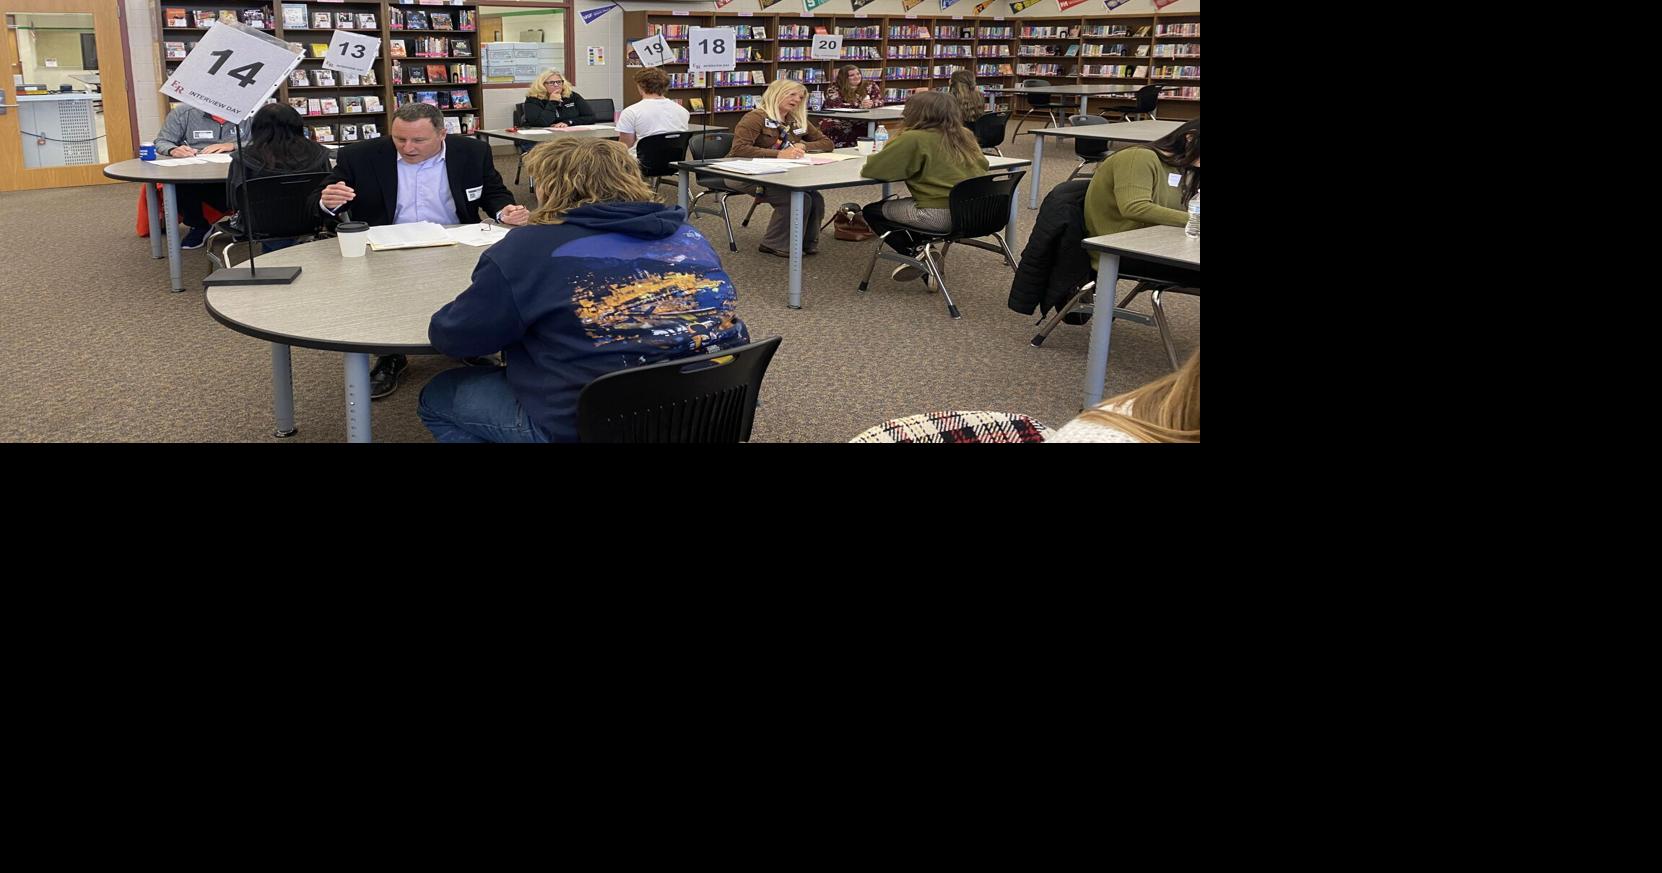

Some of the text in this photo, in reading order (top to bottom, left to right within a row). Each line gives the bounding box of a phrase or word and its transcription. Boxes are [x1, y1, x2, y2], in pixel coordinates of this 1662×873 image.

[339, 41, 366, 58] 13
[643, 42, 664, 56] 19
[698, 38, 726, 54] 18
[818, 40, 837, 50] 20
[207, 49, 265, 88] 14
[189, 90, 241, 115] INTERVIEW DAY
